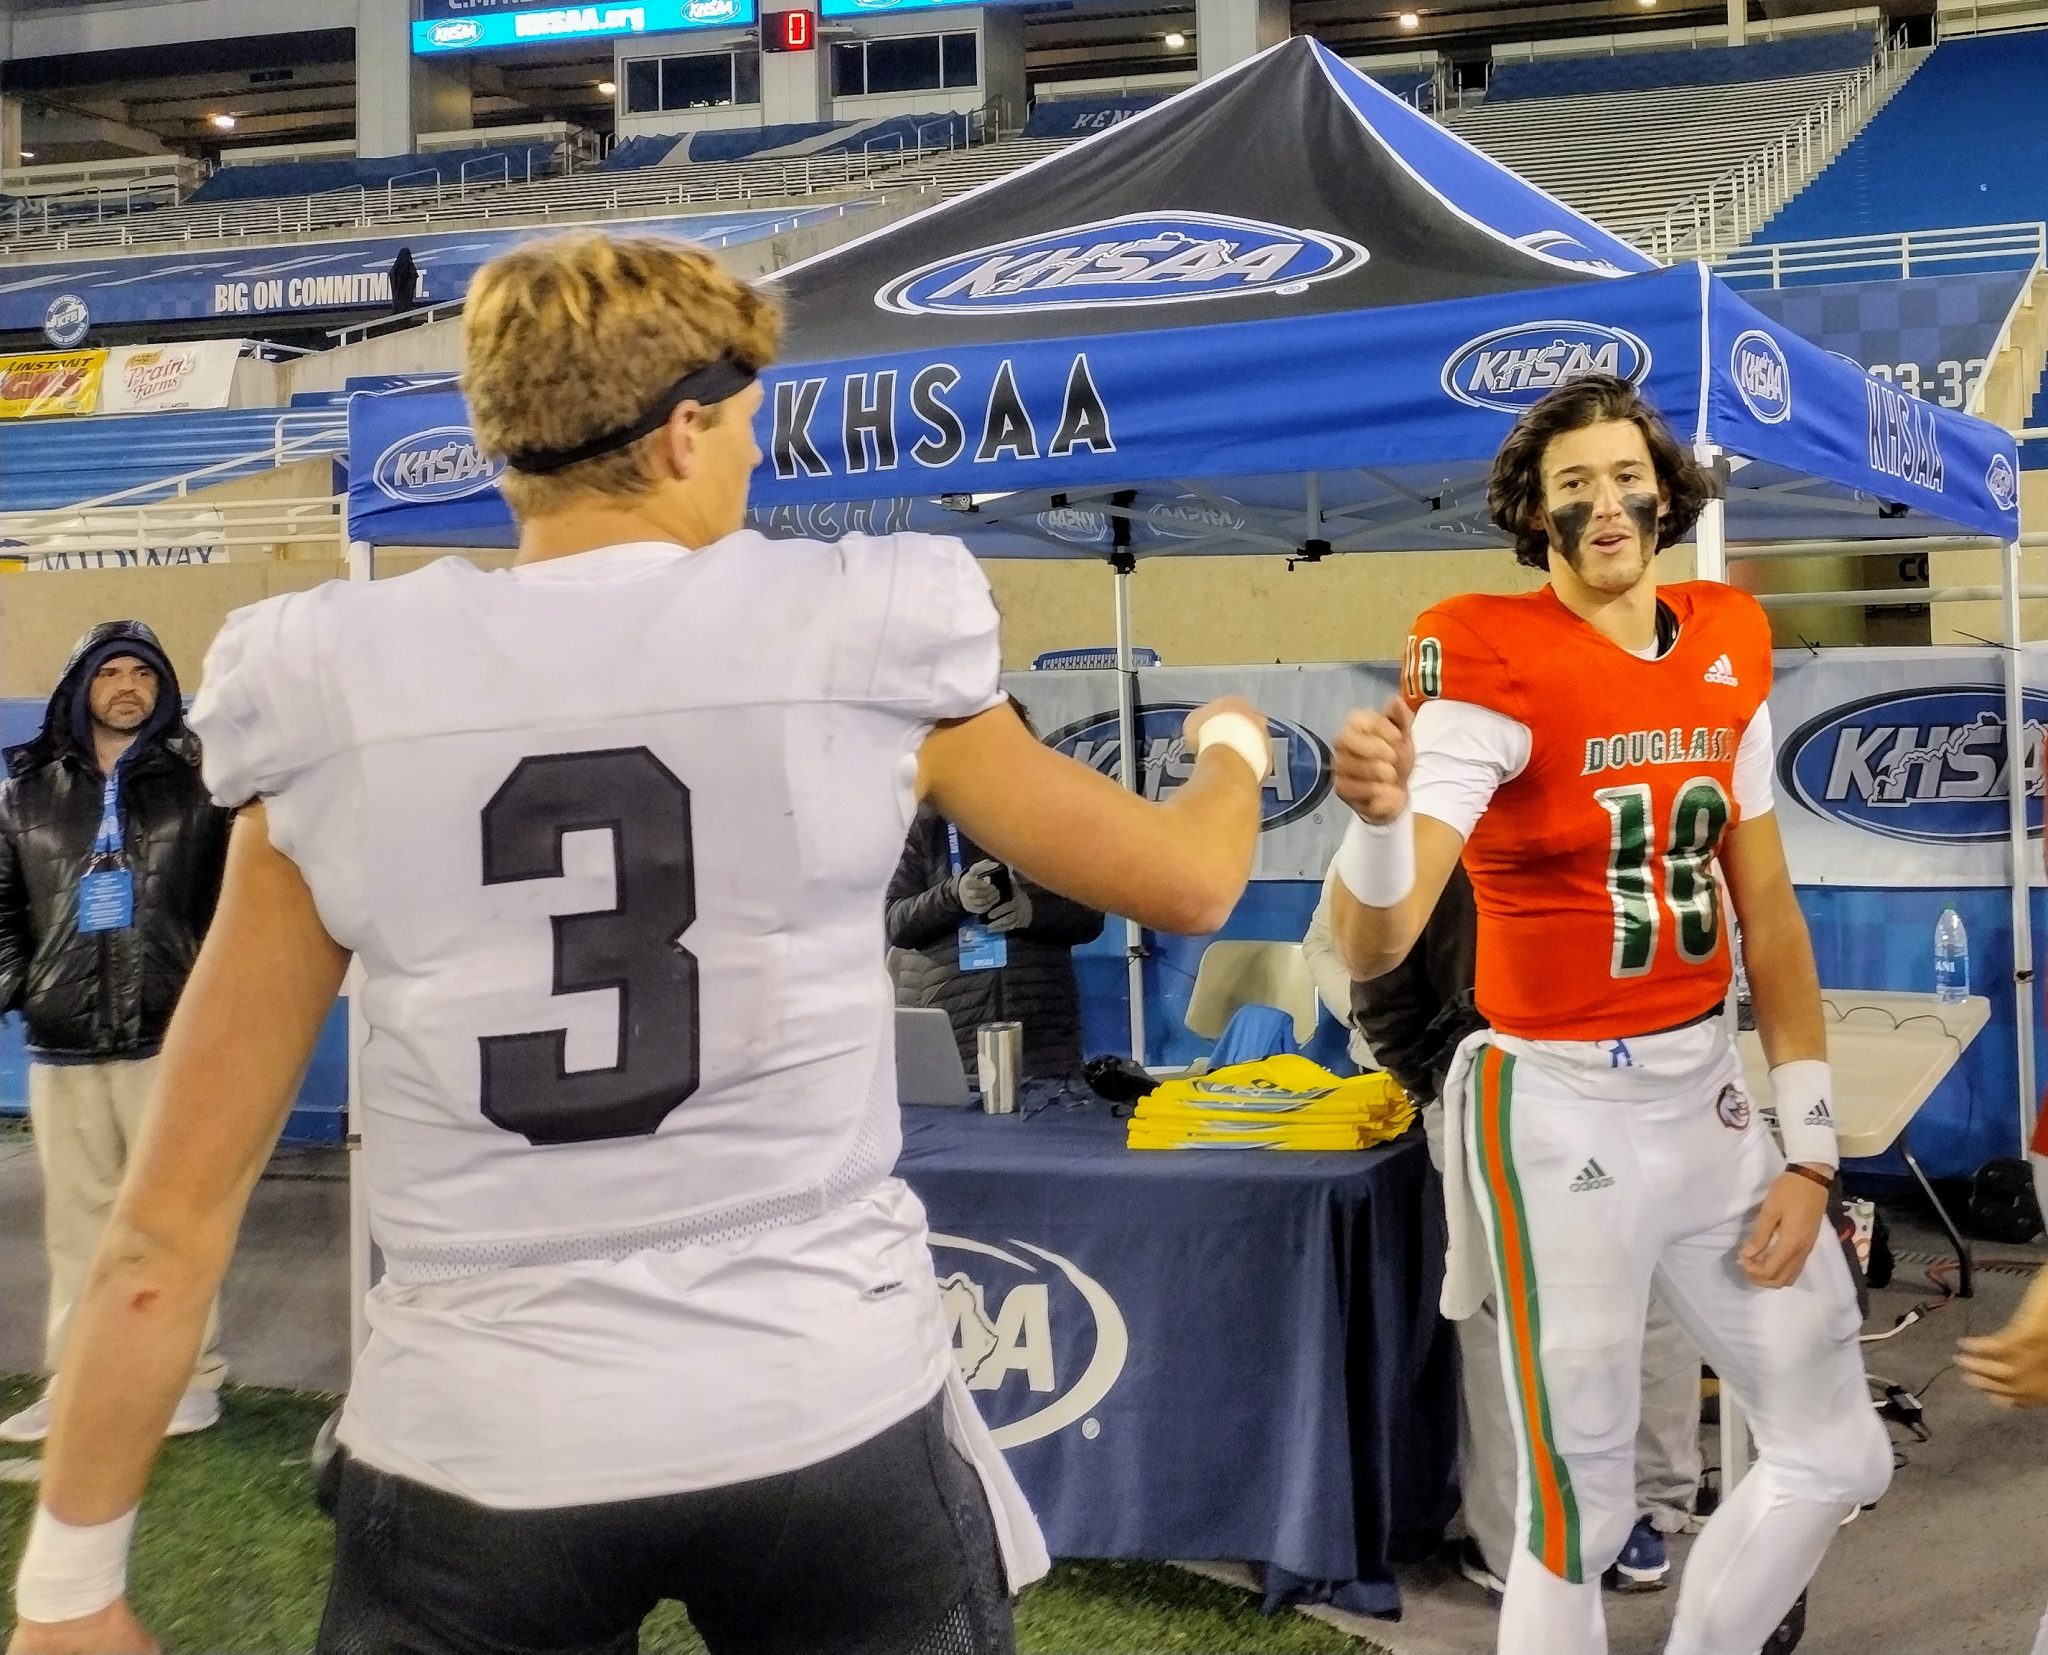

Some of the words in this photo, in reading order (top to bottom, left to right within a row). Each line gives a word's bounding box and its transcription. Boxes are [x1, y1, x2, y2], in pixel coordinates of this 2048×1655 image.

[788, 13, 806, 45] 0
[1071, 109, 1144, 130] KEN
[215, 283, 249, 313] BIG
[254, 280, 283, 310] ON
[288, 269, 430, 307] COMMITMT.
[926, 241, 1304, 300] KHSAA
[15, 357, 94, 372] INSTANT
[133, 376, 179, 399] Farms
[1468, 342, 1620, 391] KHSAA
[1741, 350, 1784, 403] KHSAA
[770, 352, 1118, 481] KHSAA
[1865, 377, 1944, 494] KHSAA
[394, 444, 494, 487] KHSAA
[1825, 720, 2046, 802] KHSA
[478, 745, 701, 1147] 3
